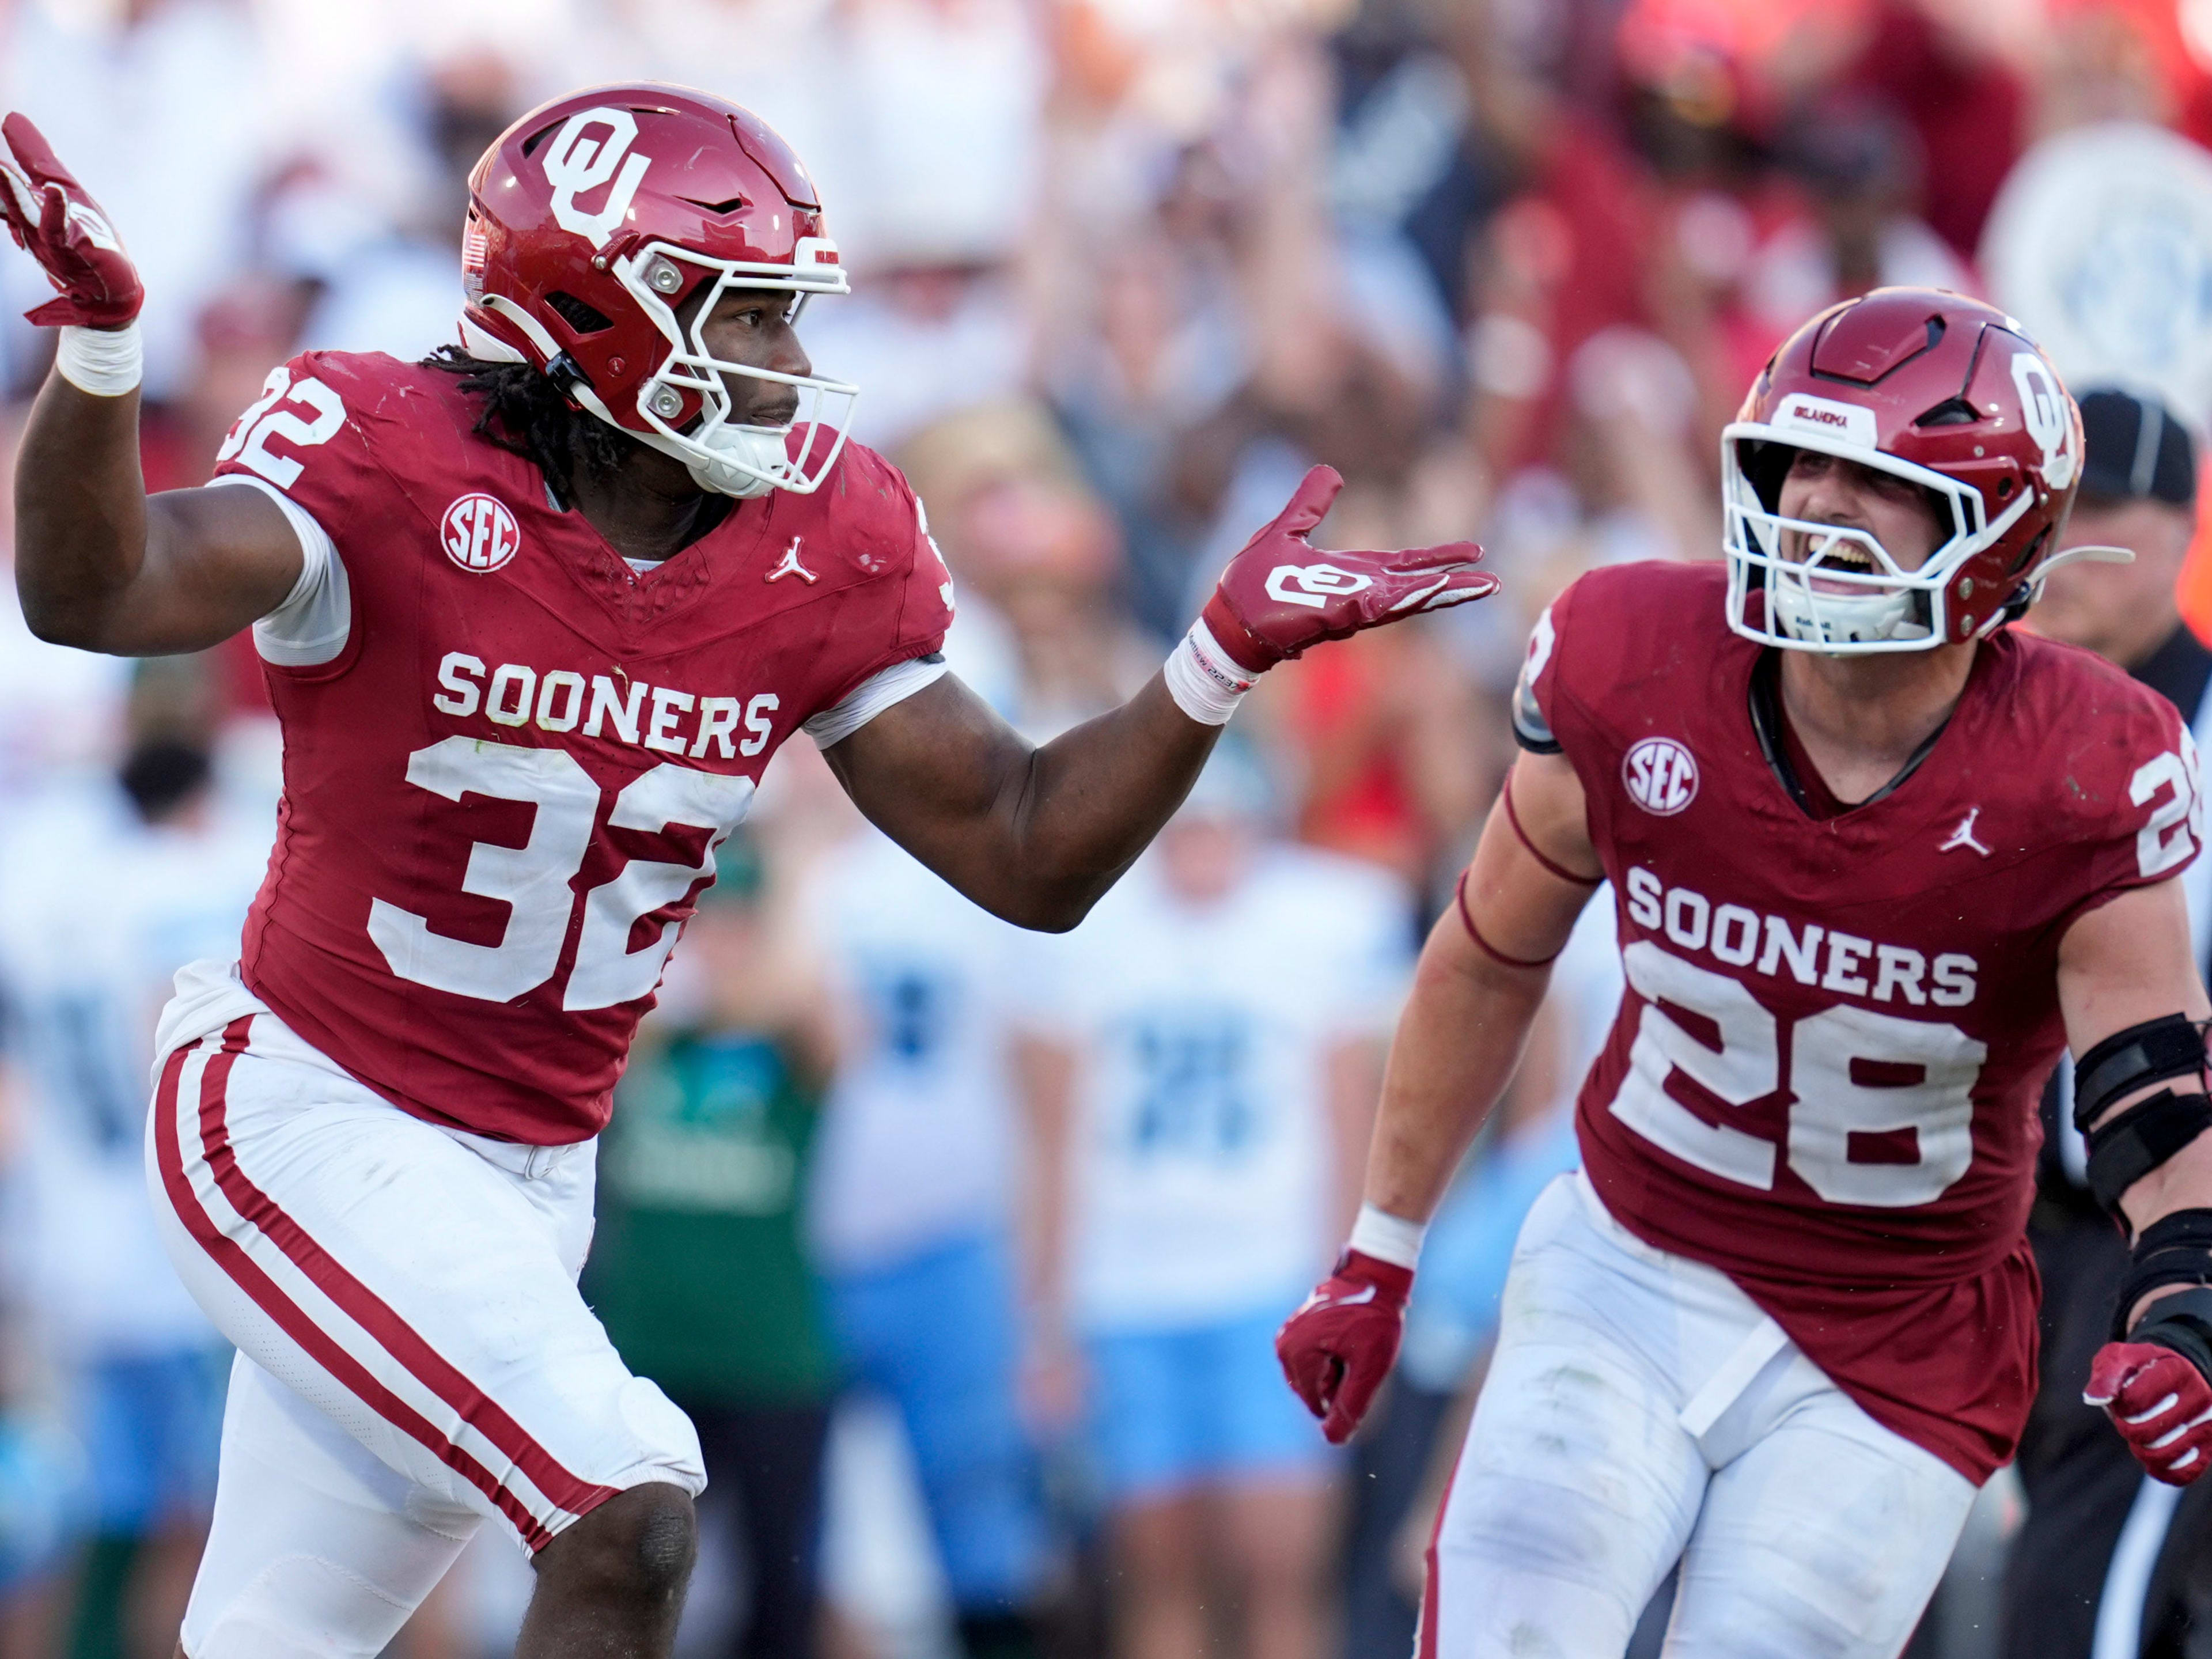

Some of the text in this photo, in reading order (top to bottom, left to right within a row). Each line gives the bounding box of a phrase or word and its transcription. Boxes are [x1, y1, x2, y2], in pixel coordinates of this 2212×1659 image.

[542, 107, 652, 250] OU
[216, 366, 347, 490] 32
[1793, 406, 1847, 429] OKLAHOMA
[448, 500, 514, 567] SEC
[433, 652, 779, 759] SOONERS
[1629, 746, 1694, 810] SEC
[366, 736, 756, 1011] 32
[1627, 866, 1978, 1007] SOONERS
[1608, 940, 1988, 1208] 28
